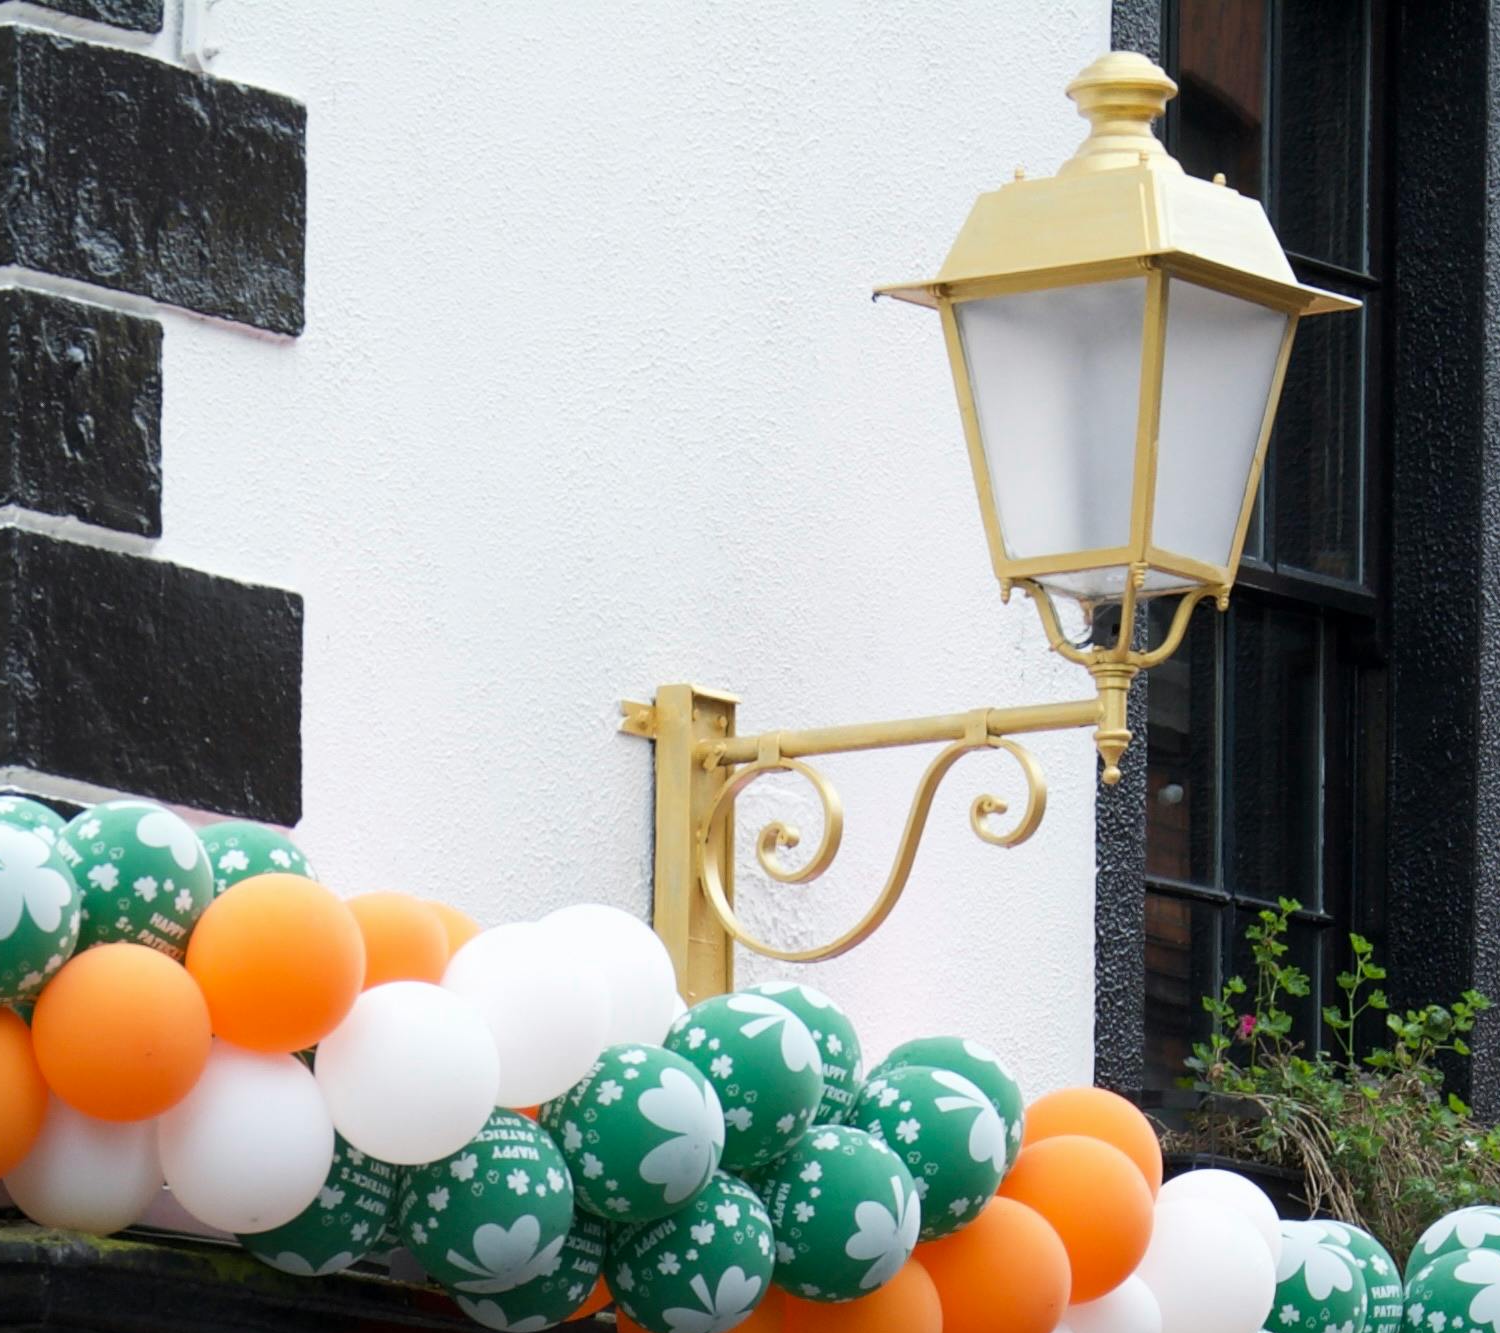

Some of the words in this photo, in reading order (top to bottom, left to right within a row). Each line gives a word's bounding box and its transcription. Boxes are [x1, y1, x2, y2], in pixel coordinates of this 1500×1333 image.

[149, 911, 187, 939] HAPPY
[490, 1144, 541, 1161] HAPPY
[354, 1193, 388, 1217] HAPPY
[774, 1181, 792, 1228] HAPPY
[632, 1218, 678, 1259] HAPPY
